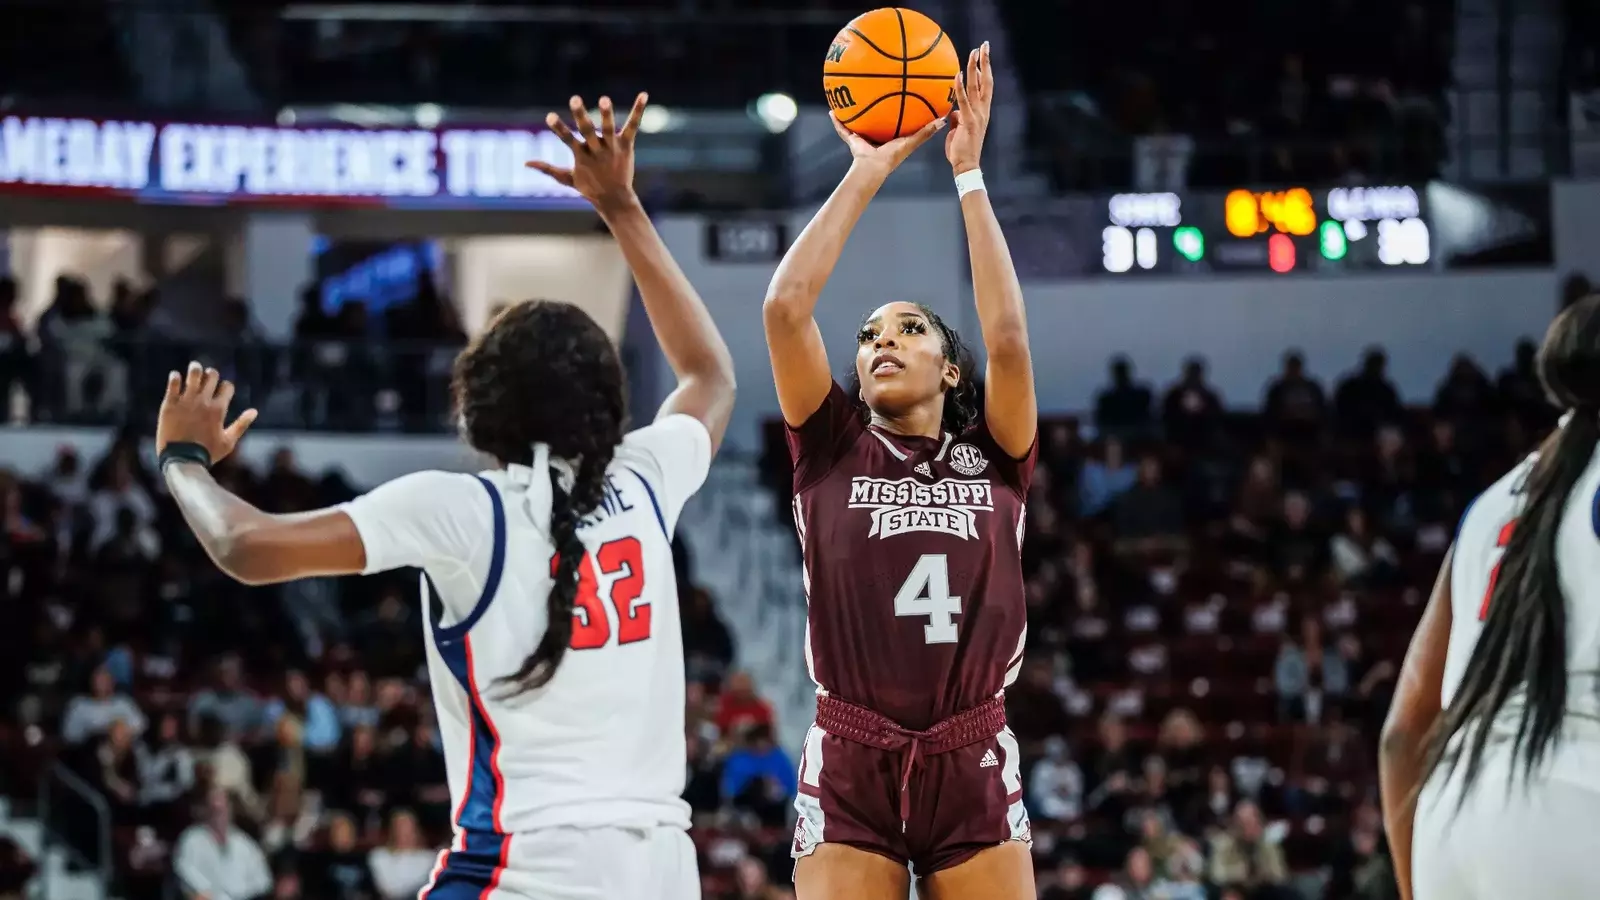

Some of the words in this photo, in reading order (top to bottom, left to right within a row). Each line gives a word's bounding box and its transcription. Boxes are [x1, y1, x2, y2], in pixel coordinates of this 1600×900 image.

[159, 122, 440, 197] EXPERIENCE
[440, 129, 600, 198] TODA
[953, 445, 980, 468] SEC
[849, 482, 993, 505] MISSISSIPPI
[889, 510, 960, 532] STATE
[893, 553, 963, 645] 4
